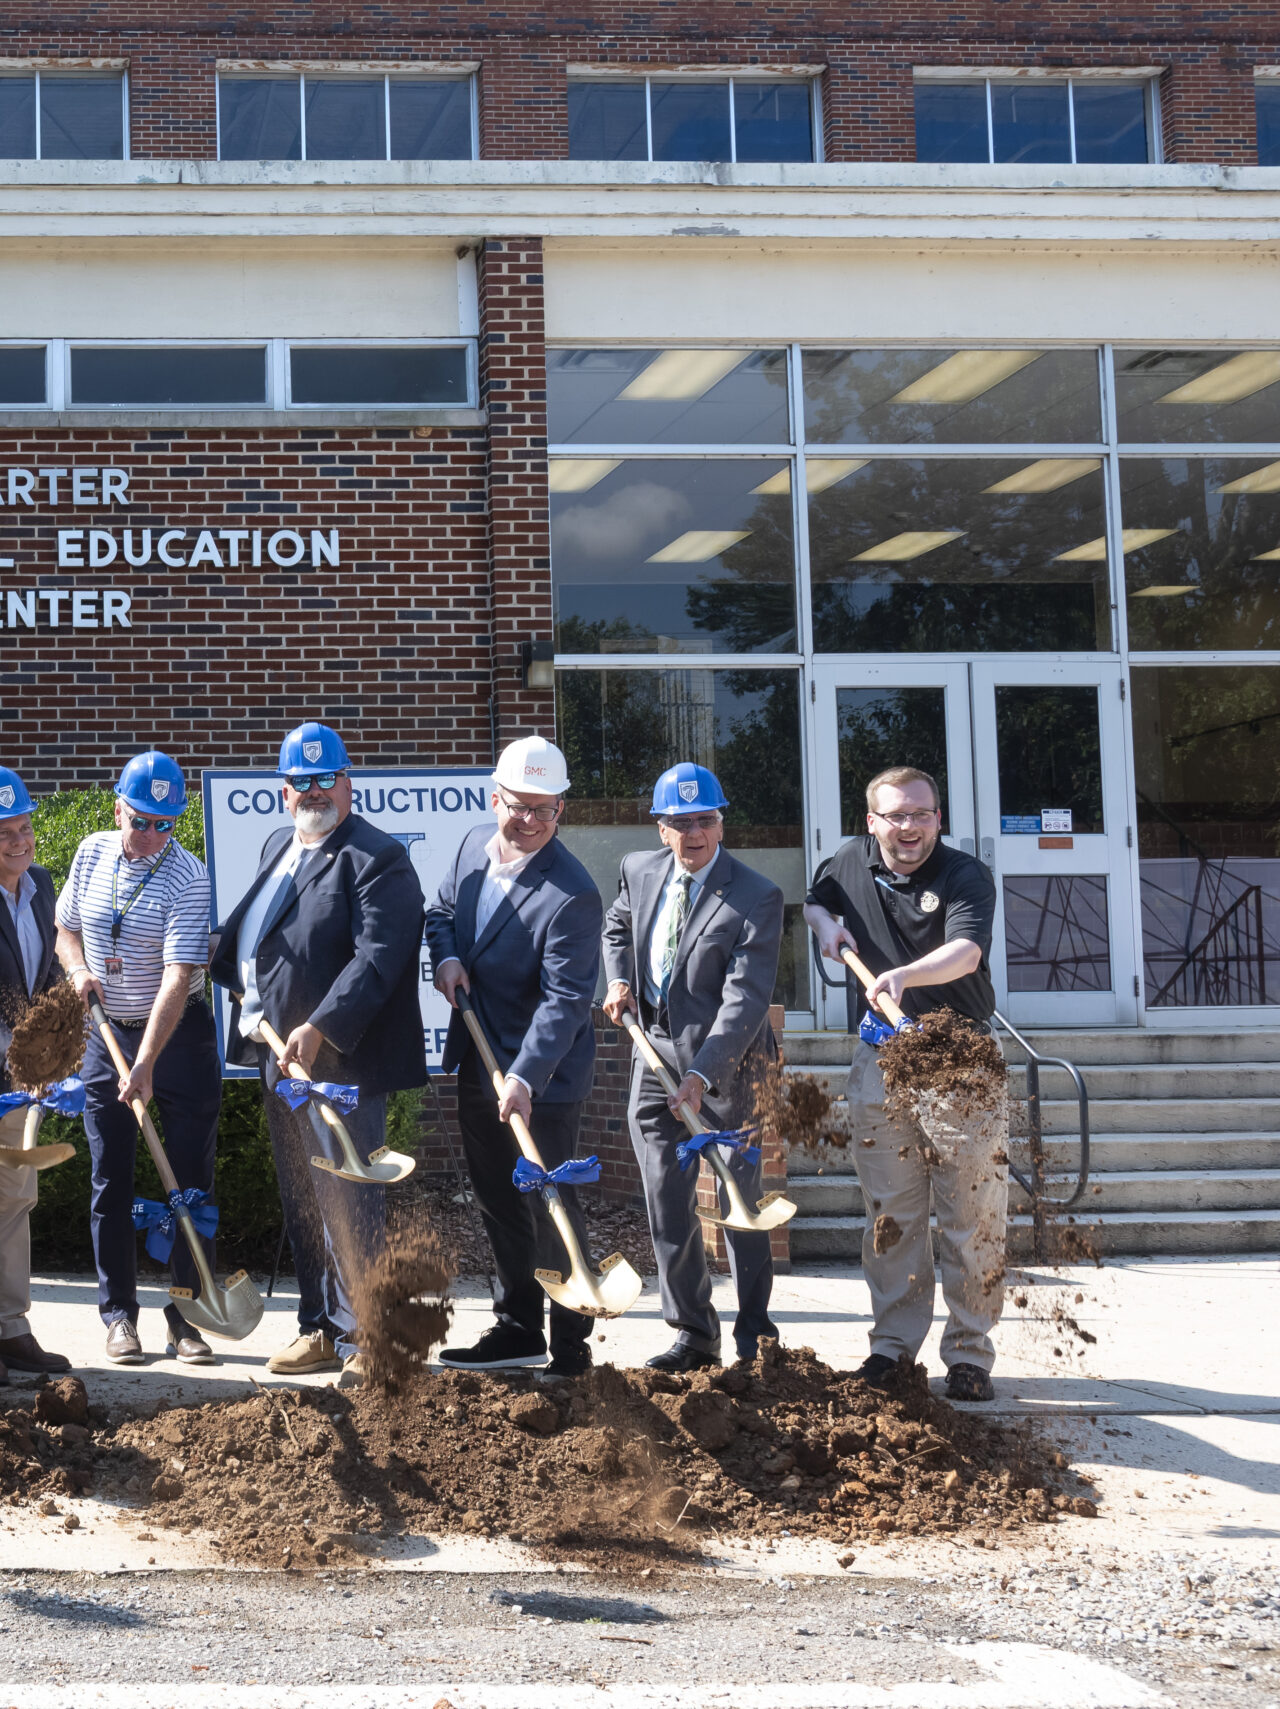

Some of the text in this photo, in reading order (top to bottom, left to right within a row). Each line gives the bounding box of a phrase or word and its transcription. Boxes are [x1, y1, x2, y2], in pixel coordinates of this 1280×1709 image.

[57, 529, 341, 568] EDUCATION
[524, 765, 547, 777] GMC
[227, 786, 487, 815] CORUCTION
